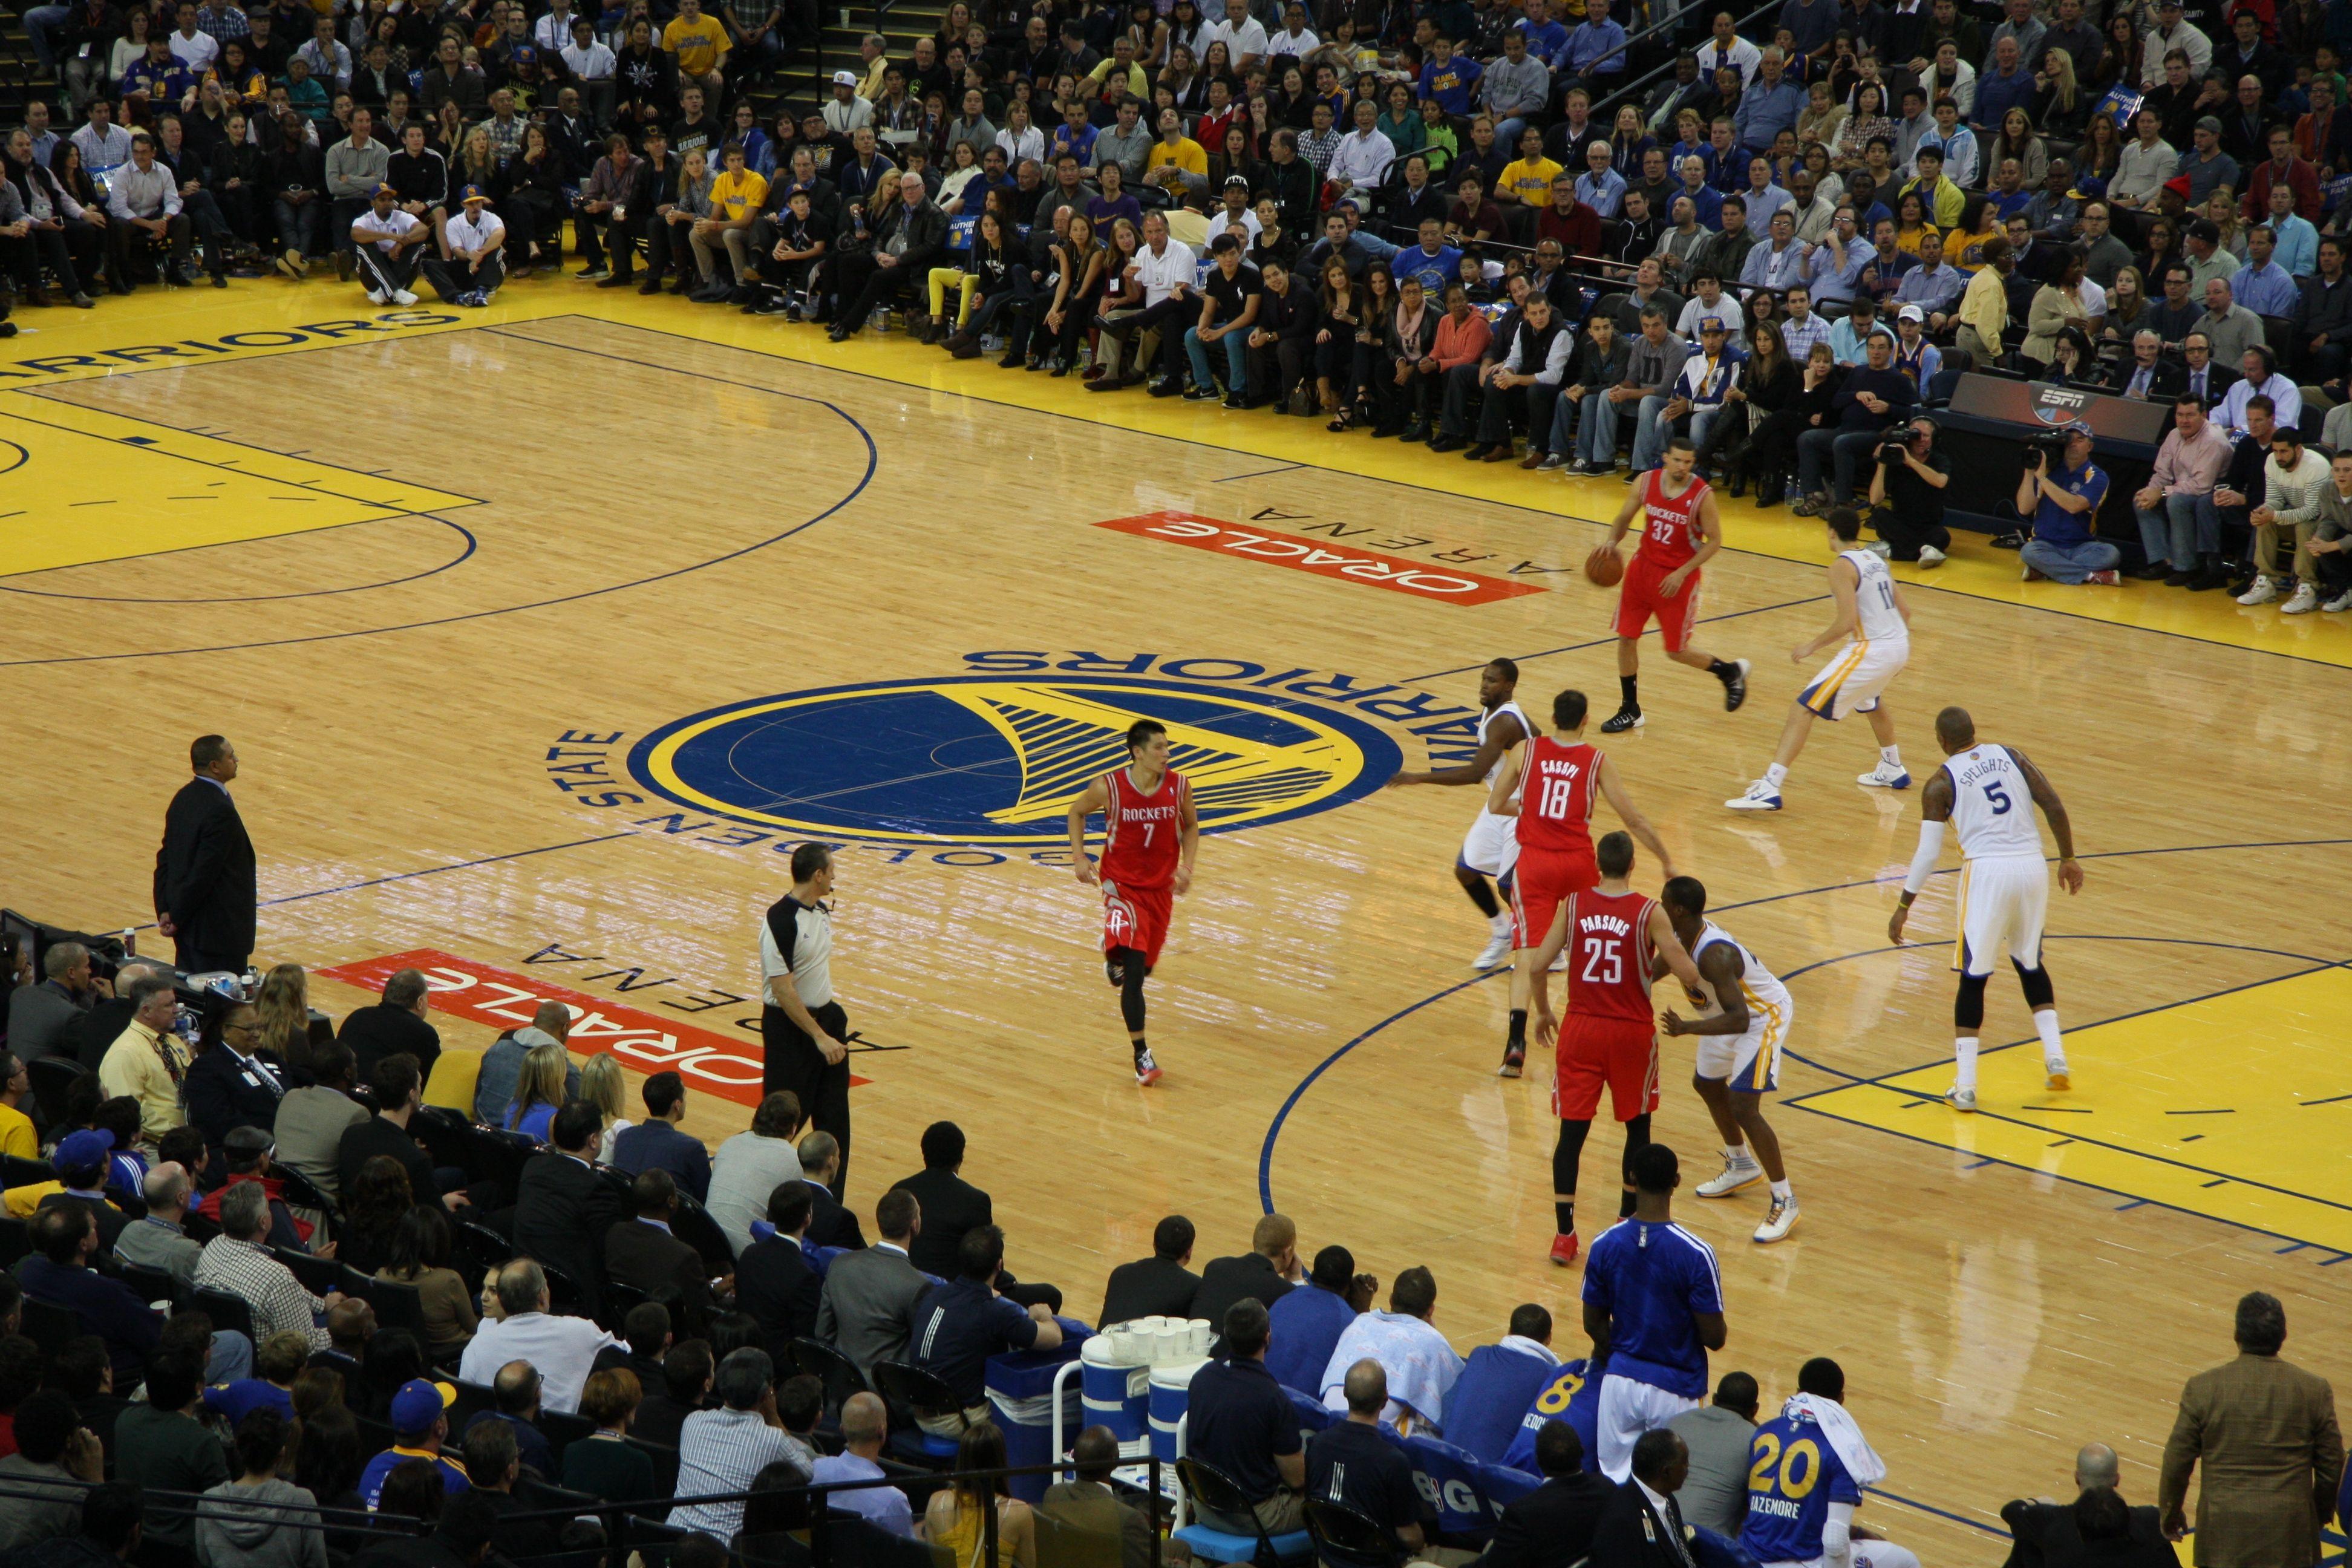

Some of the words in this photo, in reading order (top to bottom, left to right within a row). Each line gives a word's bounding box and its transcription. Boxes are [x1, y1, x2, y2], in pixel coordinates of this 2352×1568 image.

[2108, 91, 2138, 106] AUTHE
[678, 134, 708, 152] ARRIORS
[0, 310, 461, 378] RRIORS
[2040, 388, 2085, 408] ESPN
[1645, 503, 1688, 525] ROCKETS
[1250, 507, 1573, 575] ARENA
[1652, 519, 1675, 544] 32
[1145, 521, 1479, 592] ORACLE
[1878, 581, 1895, 610] 11
[546, 729, 644, 808] STATE
[1540, 760, 1579, 780] CASSPI
[1960, 758, 2010, 787] SPEIGHTS
[1539, 776, 1571, 821] 18
[1982, 780, 2012, 815] 5
[1122, 805, 1175, 823] ROCKETS
[1143, 823, 1155, 849] 7
[1579, 914, 1630, 938] PARSONS
[1582, 937, 1622, 984] 25
[521, 942, 911, 1053] AENA
[1537, 1373, 1585, 1415] 8
[1748, 1432, 1820, 1499] 20
